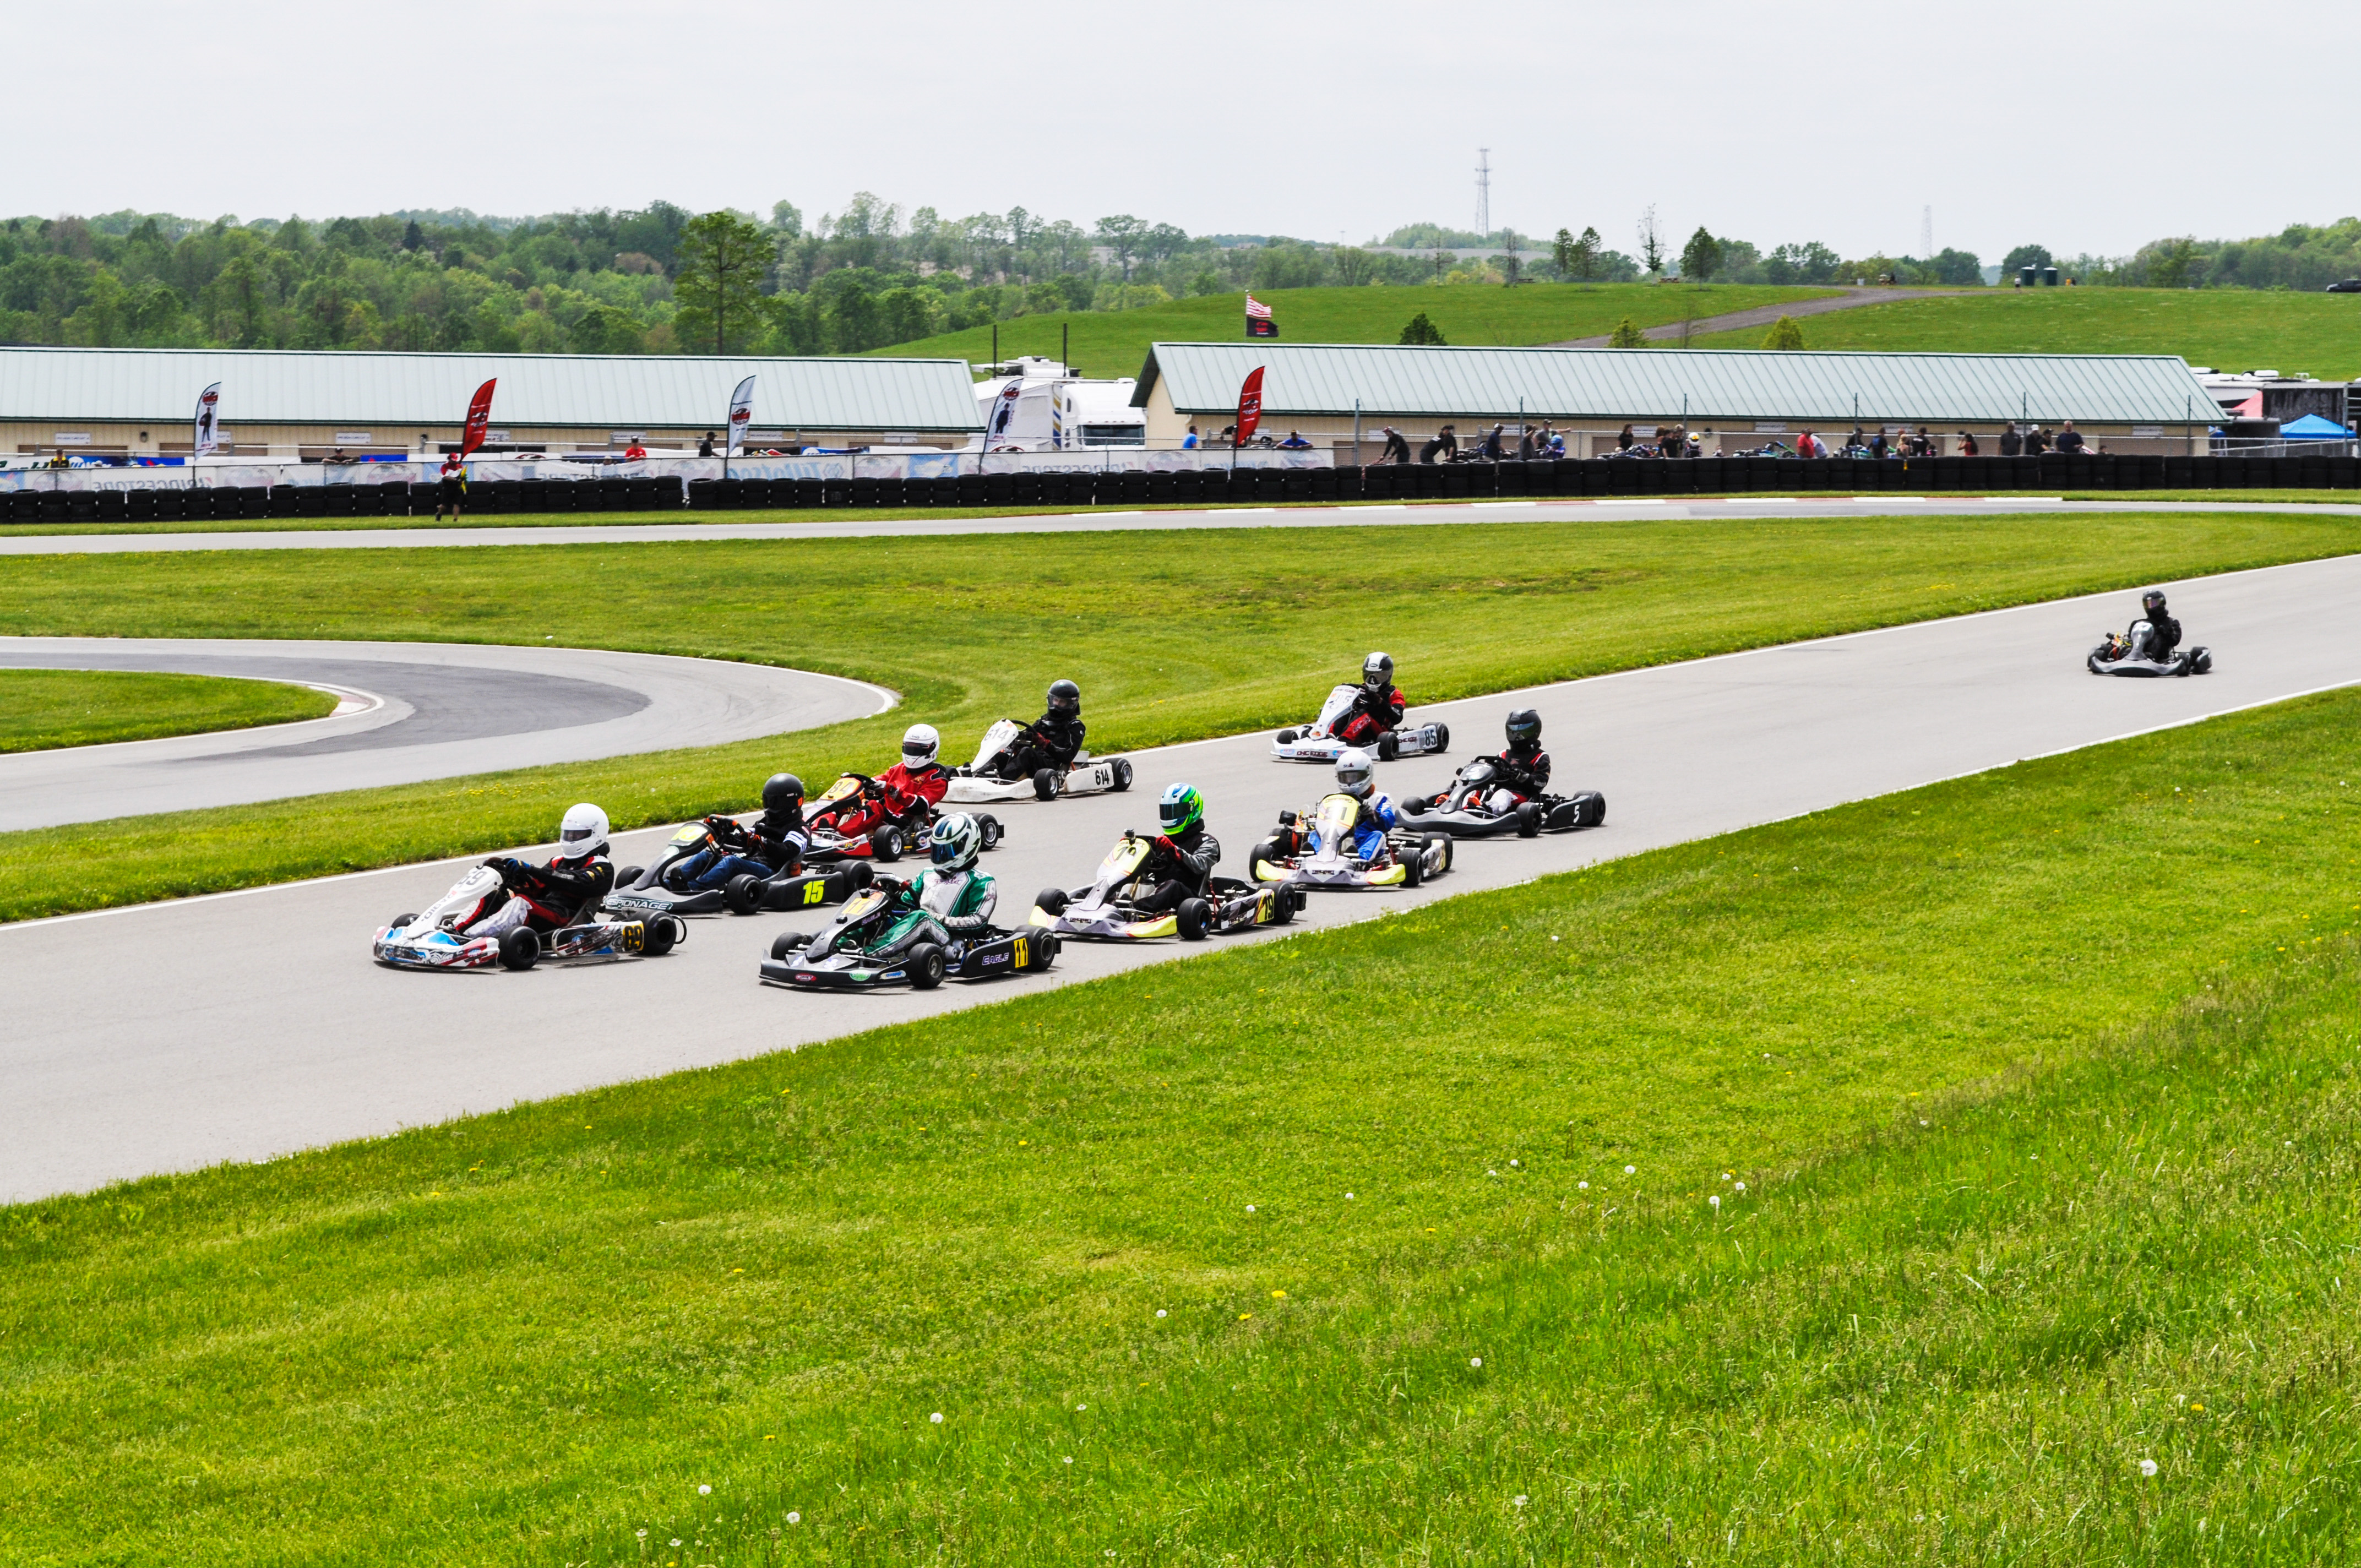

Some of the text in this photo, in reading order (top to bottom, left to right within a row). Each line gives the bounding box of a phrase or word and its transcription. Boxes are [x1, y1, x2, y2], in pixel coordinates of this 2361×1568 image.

[984, 727, 1009, 741] 614
[1424, 729, 1436, 746] 85
[1095, 769, 1109, 786] 614
[828, 781, 855, 794] 84
[1573, 804, 1580, 824] 5
[803, 880, 825, 905] 15
[606, 897, 670, 910] ESPIONAGE
[846, 898, 870, 914] 11
[1261, 894, 1274, 921] 19
[624, 925, 643, 951] 69
[982, 952, 1009, 966] EAGLE
[1015, 938, 1027, 967] 11
